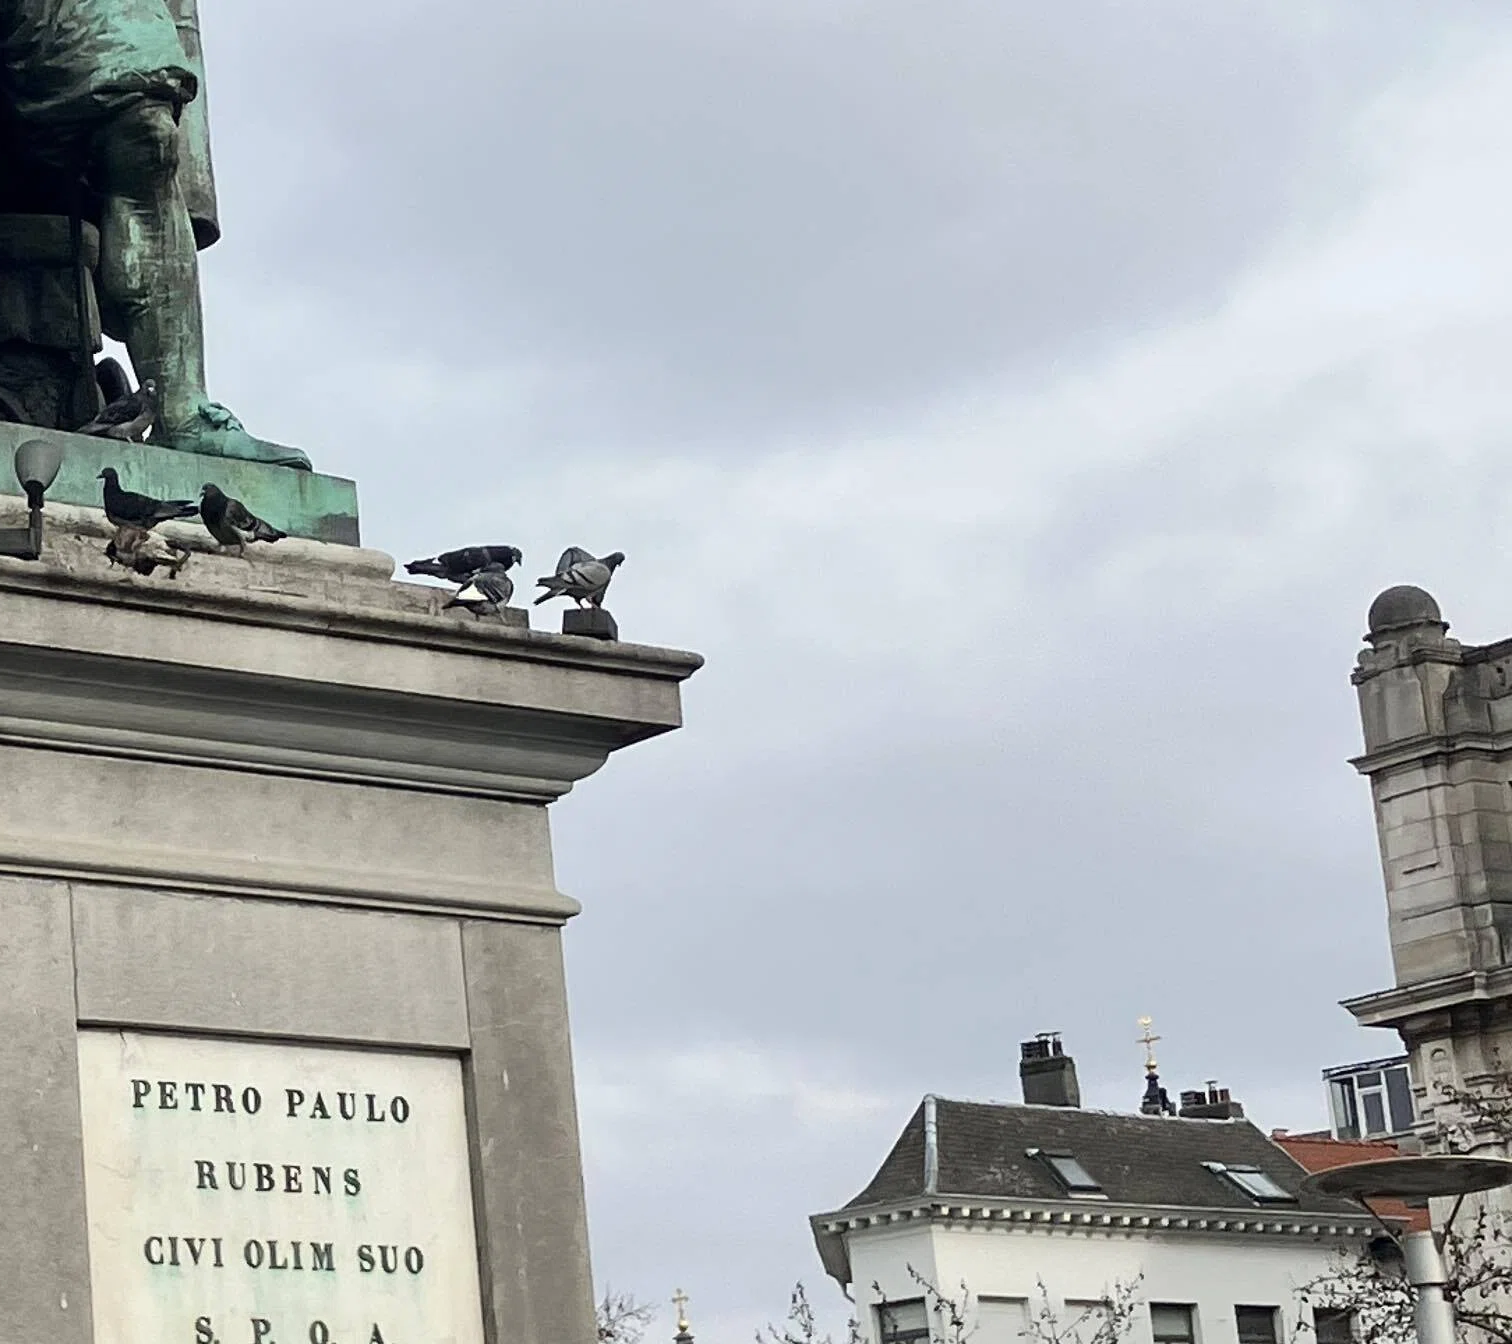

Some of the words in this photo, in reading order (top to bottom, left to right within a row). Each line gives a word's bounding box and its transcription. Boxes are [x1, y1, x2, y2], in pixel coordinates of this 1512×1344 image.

[130, 1079, 262, 1115] PETRO
[285, 1088, 410, 1124] PAULO
[194, 1160, 361, 1197] RUBENS
[144, 1236, 224, 1268] CIVI
[243, 1239, 336, 1272] OLIM
[357, 1244, 424, 1275] SUO
